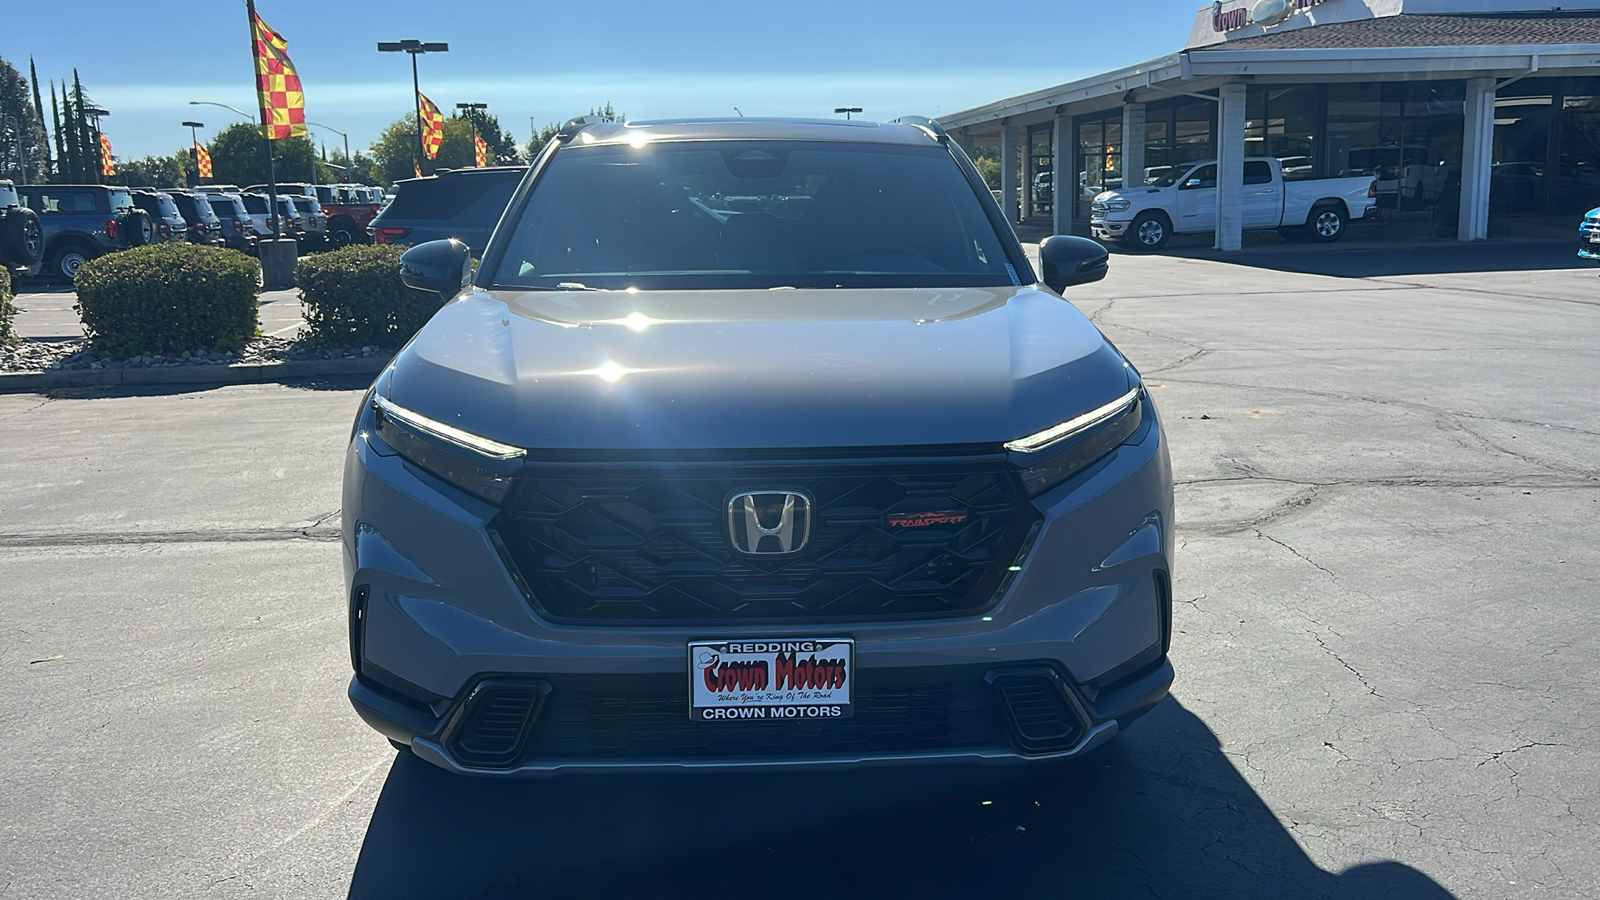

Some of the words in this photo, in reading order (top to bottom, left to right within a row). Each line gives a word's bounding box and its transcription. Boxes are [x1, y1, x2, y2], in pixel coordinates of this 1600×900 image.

[889, 516, 966, 527] TRAILSPORT
[729, 642, 814, 653] REDDING
[703, 654, 769, 693] Crown
[775, 652, 847, 691] Motors
[740, 693, 764, 704] You're
[766, 692, 784, 702] King
[785, 692, 796, 701] Of
[798, 691, 811, 700] The
[813, 691, 832, 699] Road
[702, 708, 766, 720] CROWN
[770, 706, 842, 718] MOTORS
